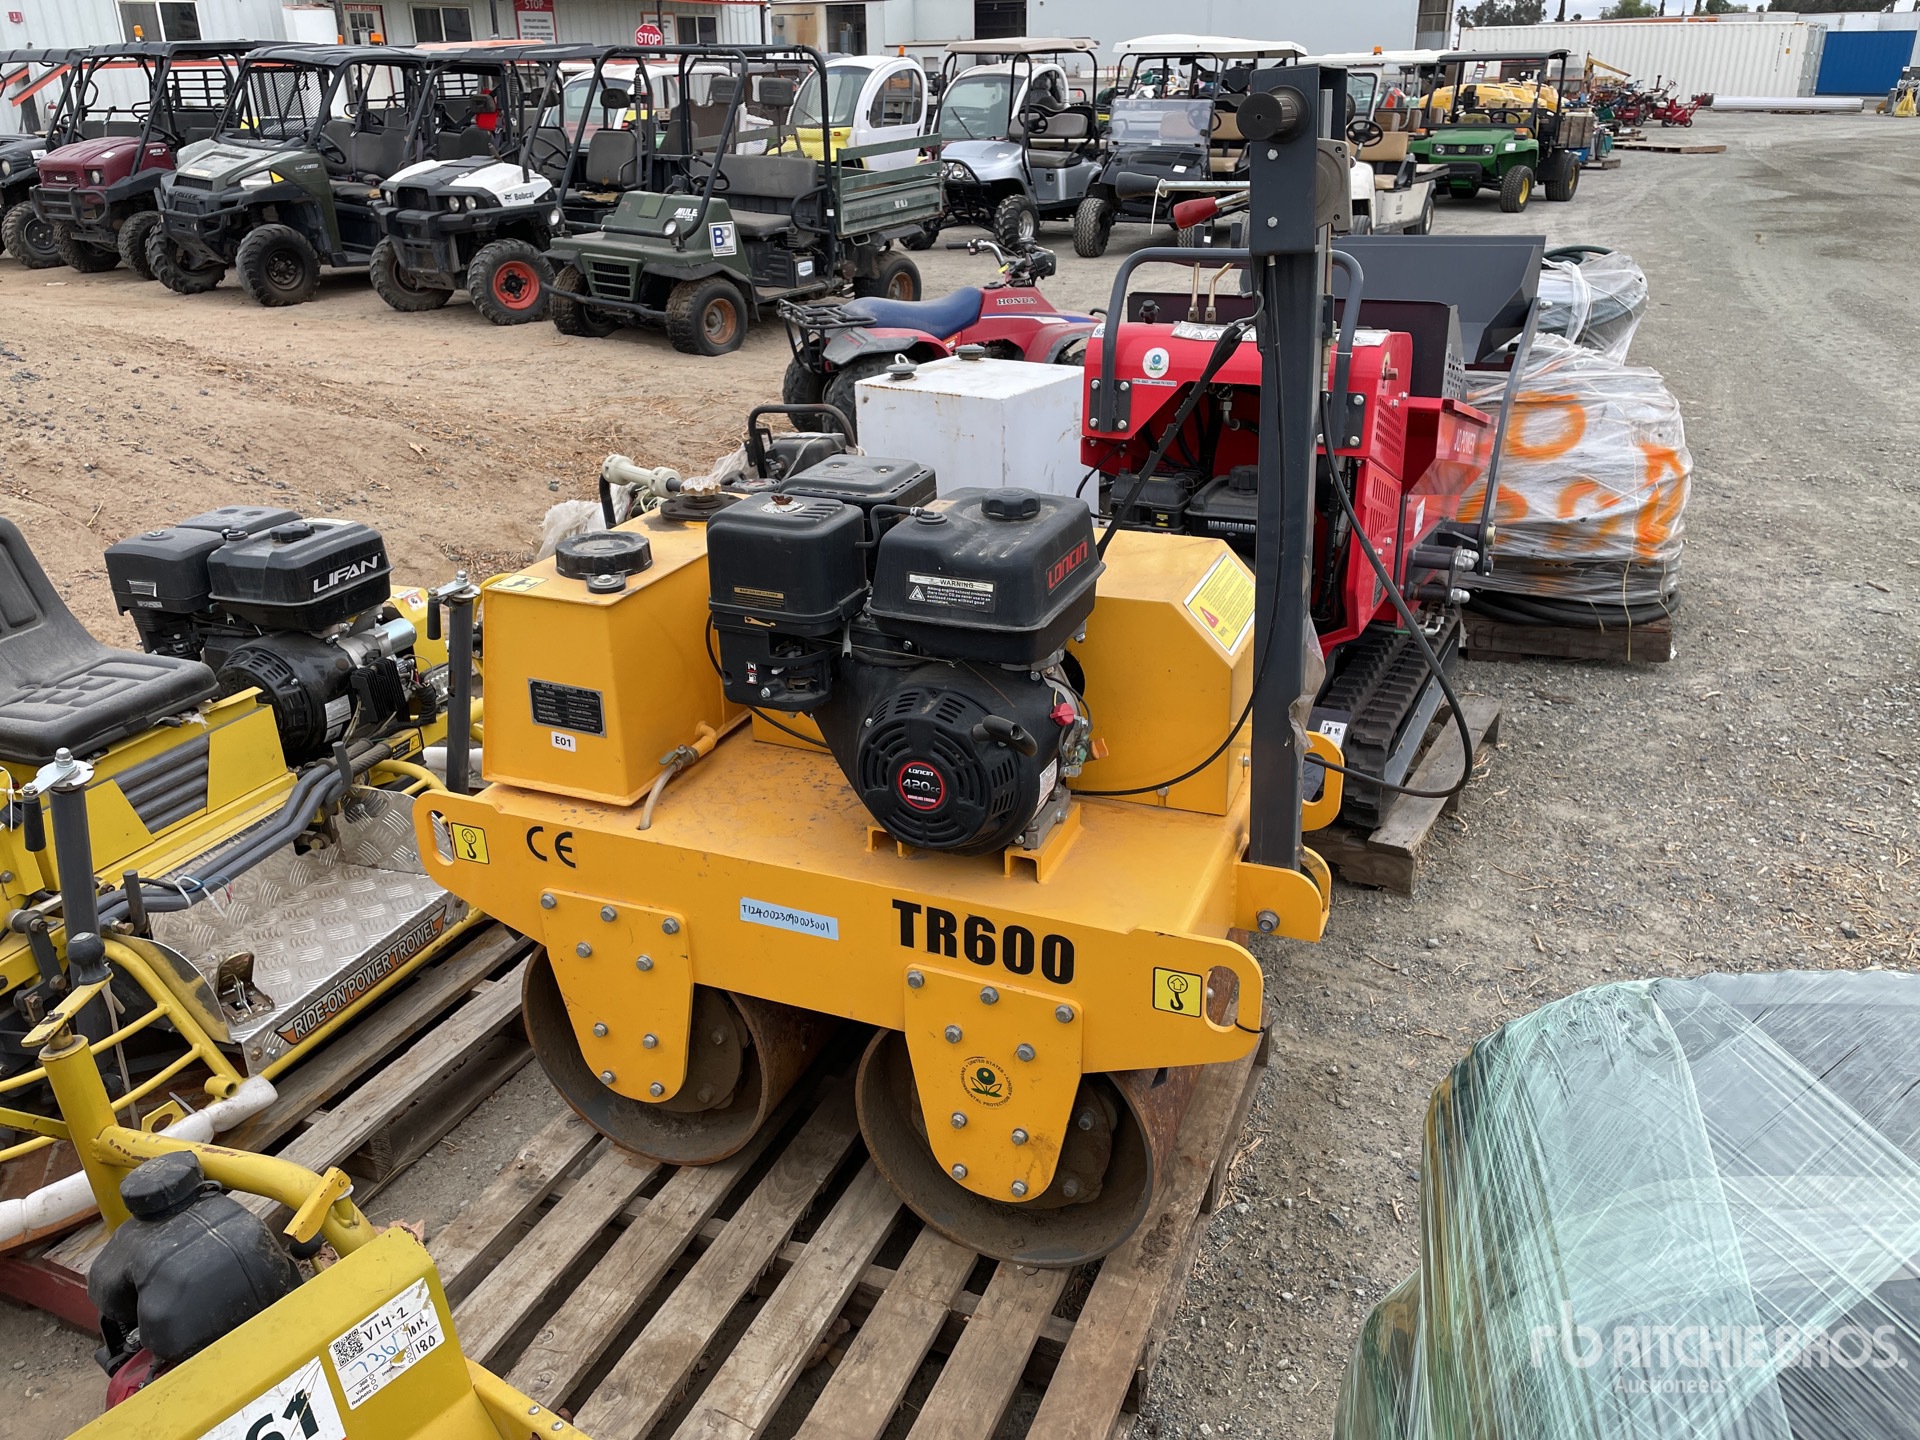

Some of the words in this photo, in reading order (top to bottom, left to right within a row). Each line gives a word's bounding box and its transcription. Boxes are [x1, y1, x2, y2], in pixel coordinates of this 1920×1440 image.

[637, 32, 660, 45] STOP
[514, 191, 535, 201] Bobcat
[674, 208, 698, 217] MULE
[997, 297, 1037, 306] HONDA
[1207, 520, 1256, 534] VANGUARD
[314, 555, 378, 593] LIFAN
[940, 580, 974, 588] WARNING
[555, 736, 571, 748] E01
[526, 826, 576, 868] CE
[892, 898, 1075, 985] TR600
[293, 985, 346, 1040] RIDE-ON
[348, 952, 392, 999] POWER
[391, 919, 438, 964] TROWEL
[416, 1335, 436, 1354] 180
[356, 1384, 370, 1396] Video
